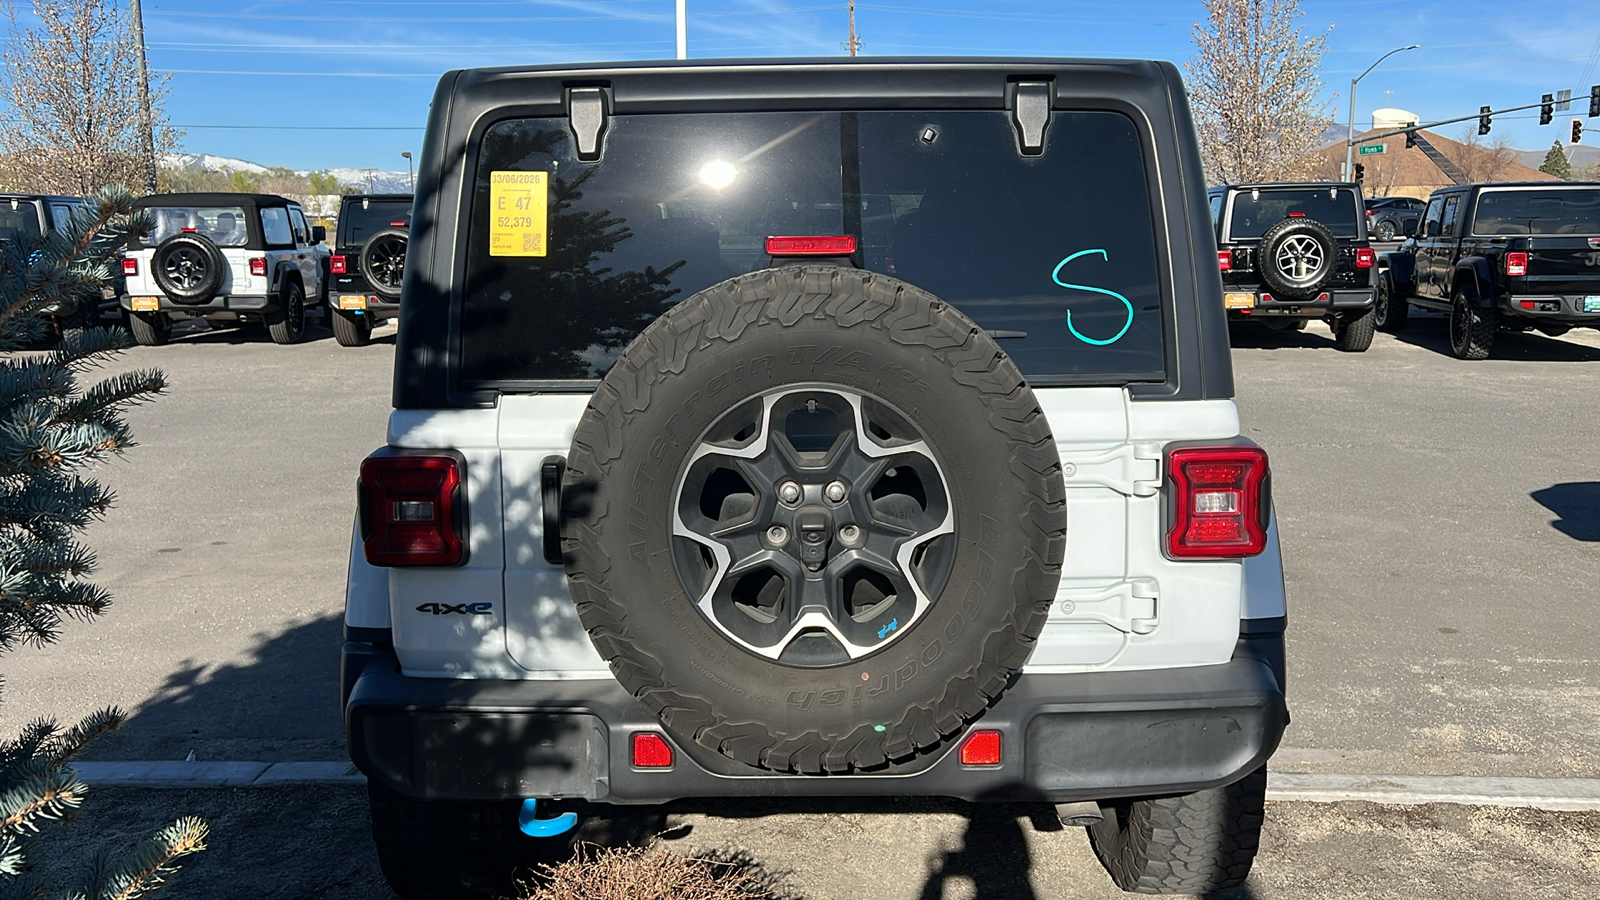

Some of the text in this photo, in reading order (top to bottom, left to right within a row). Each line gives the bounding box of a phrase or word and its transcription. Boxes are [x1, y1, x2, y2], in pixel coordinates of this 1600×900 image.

[498, 196, 531, 210] E 47
[498, 217, 532, 229] 52,379
[1052, 248, 1134, 345] S
[786, 344, 873, 371] T/A
[785, 512, 999, 711] BFGoodrich
